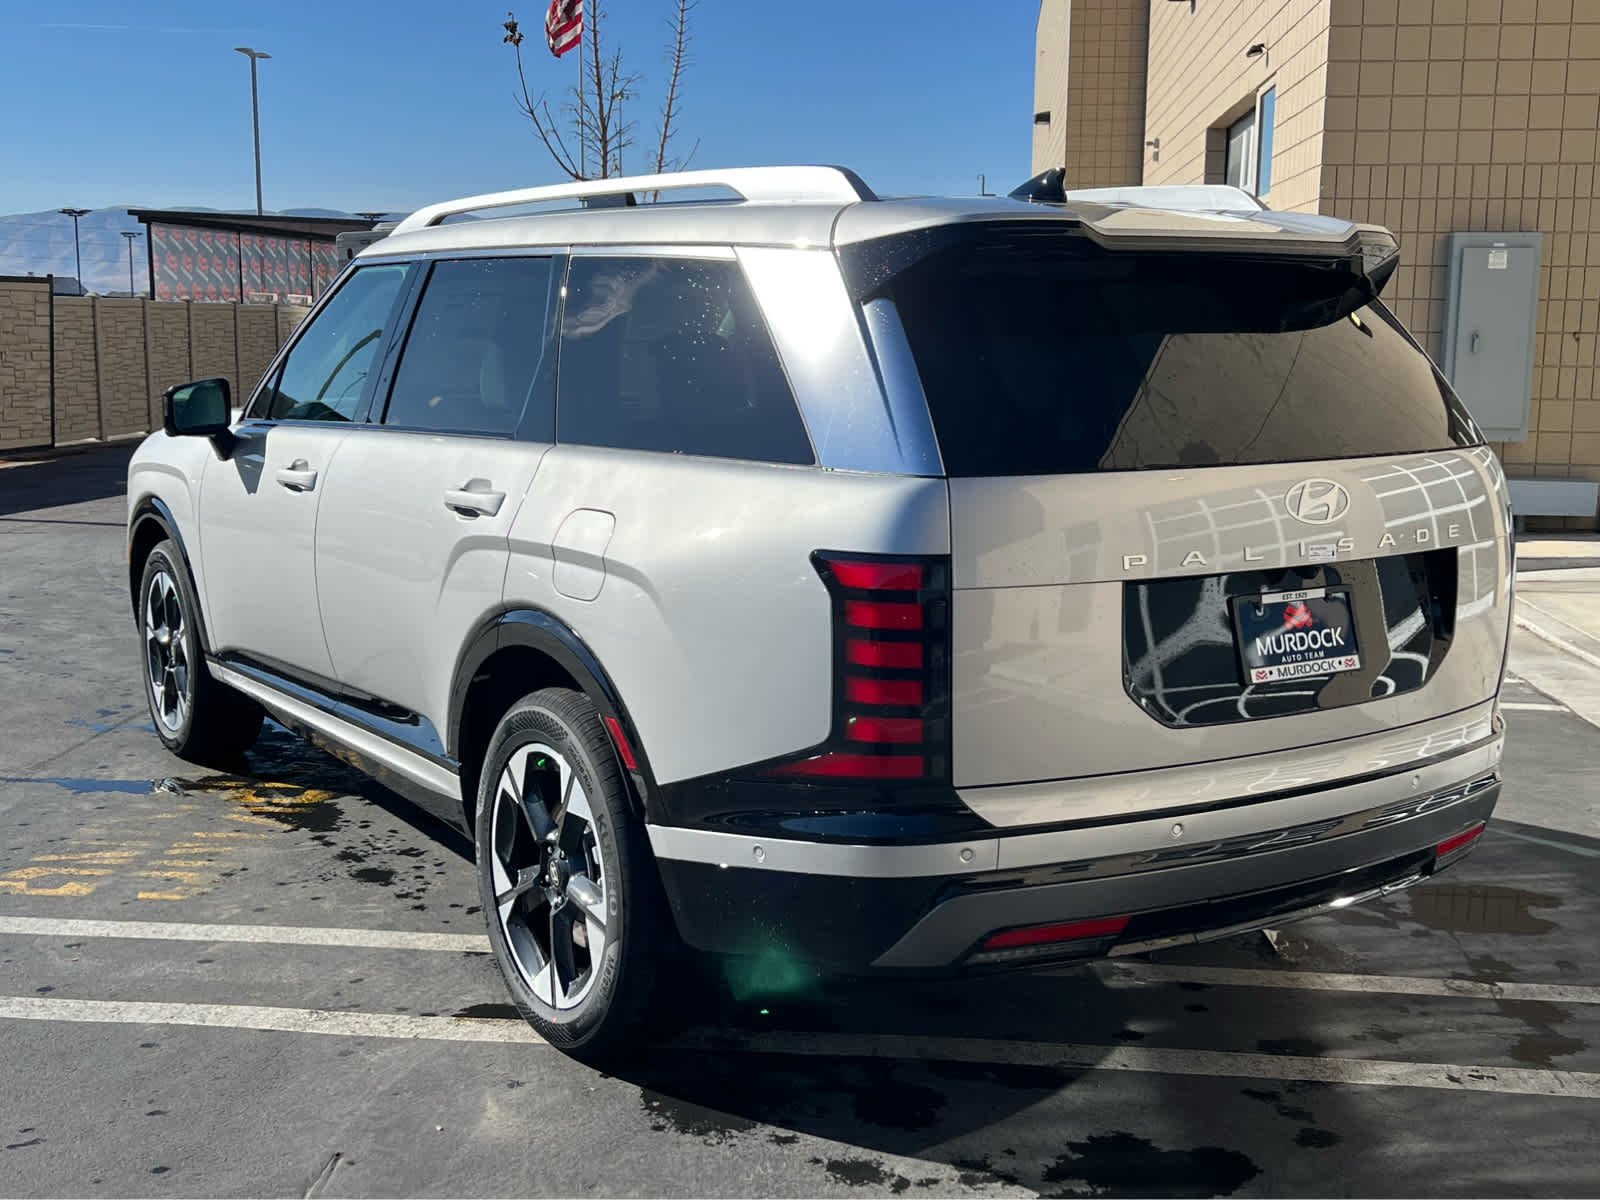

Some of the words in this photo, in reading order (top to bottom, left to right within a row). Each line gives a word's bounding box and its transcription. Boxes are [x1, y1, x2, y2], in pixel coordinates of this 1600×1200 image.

[1122, 523, 1461, 571] PALISADE
[1255, 626, 1345, 657] MURDOCK
[1281, 654, 1302, 663] AUTO
[1304, 650, 1325, 660] TEAM
[1277, 660, 1337, 678] MURDOCK
